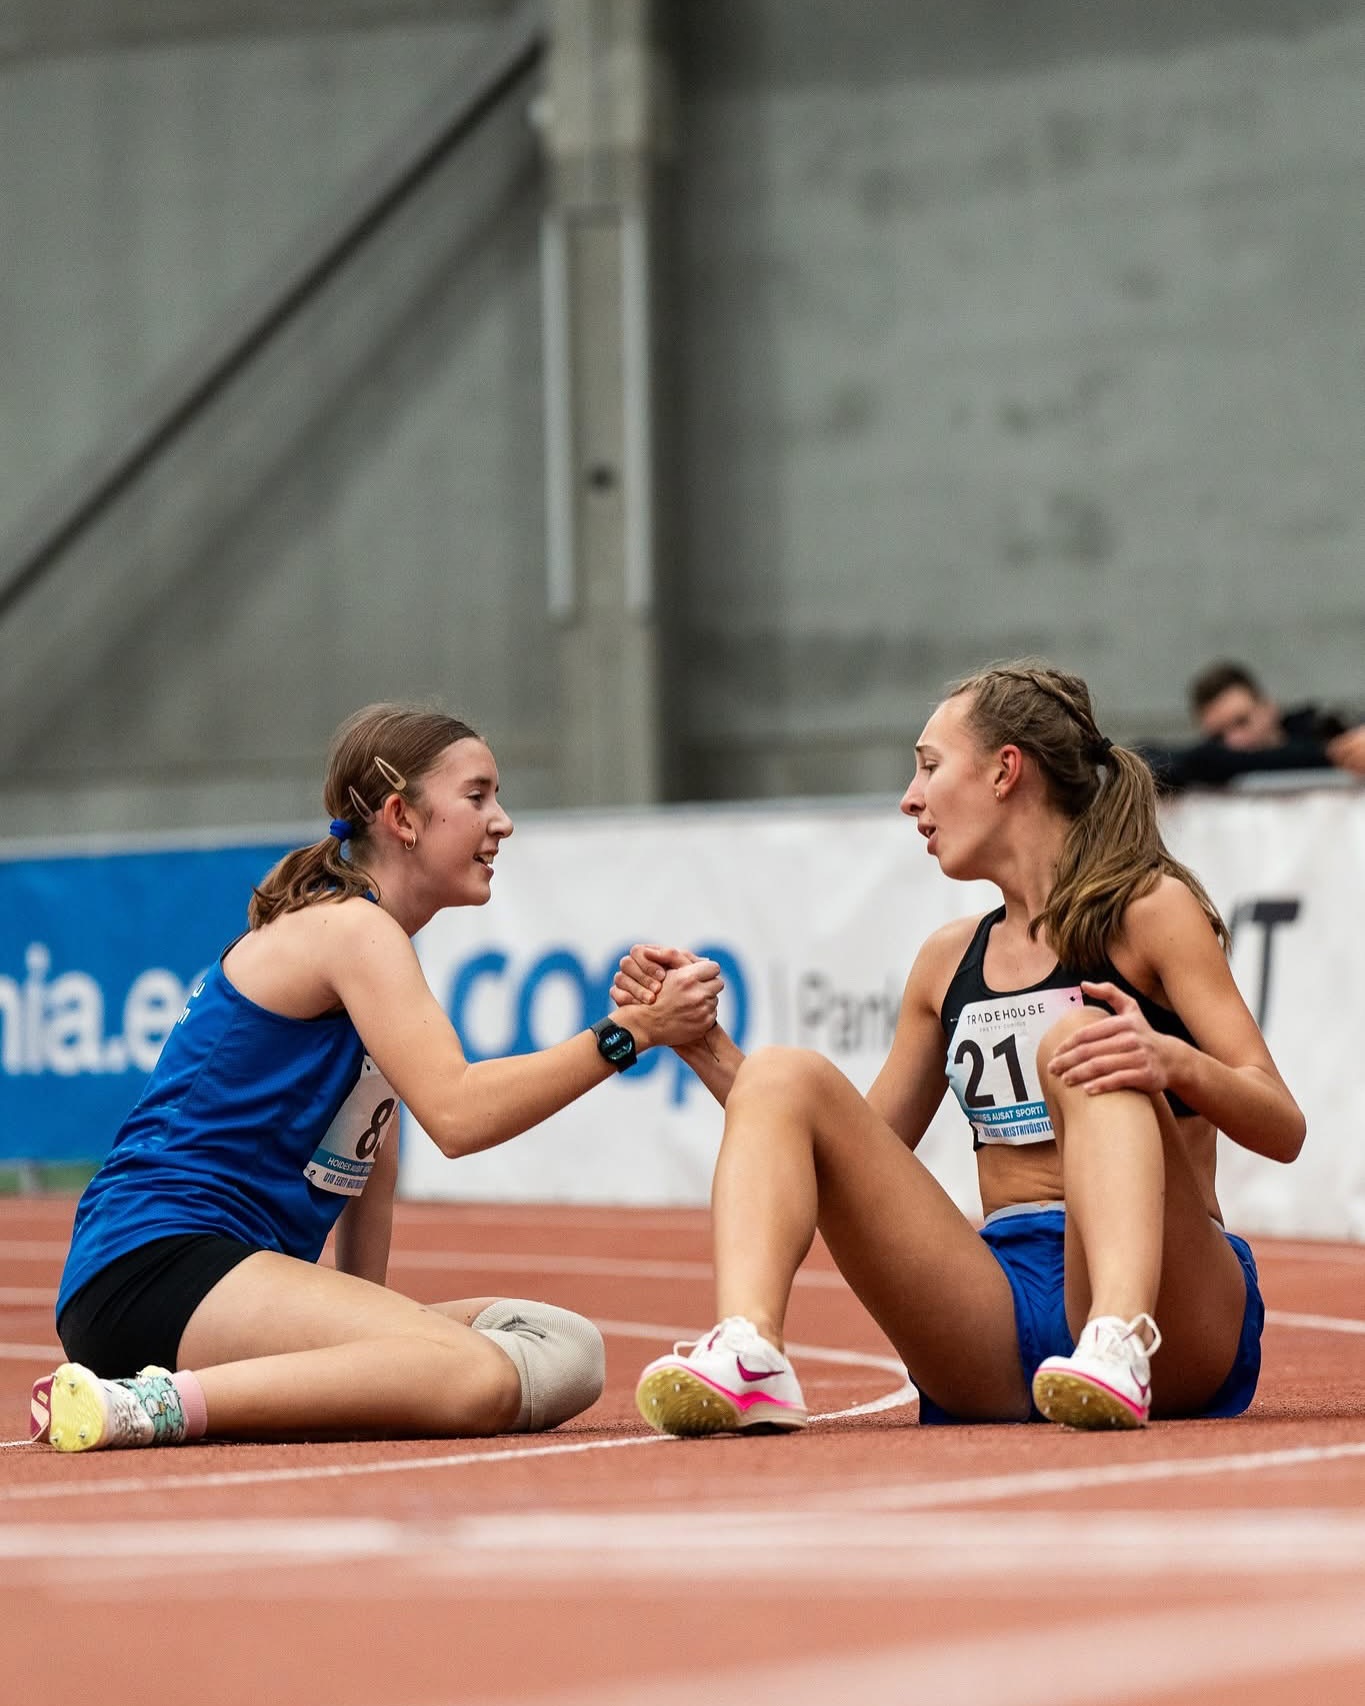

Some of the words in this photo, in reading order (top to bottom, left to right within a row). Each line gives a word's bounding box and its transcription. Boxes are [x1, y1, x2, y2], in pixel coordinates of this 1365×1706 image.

[967, 1002, 1046, 1025] TRADEHOUSE
[953, 1033, 1029, 1108] 21
[991, 1109, 1014, 1121] AUSAT
[1015, 1105, 1044, 1118] SPORTI
[327, 1156, 352, 1170] HOIDES
